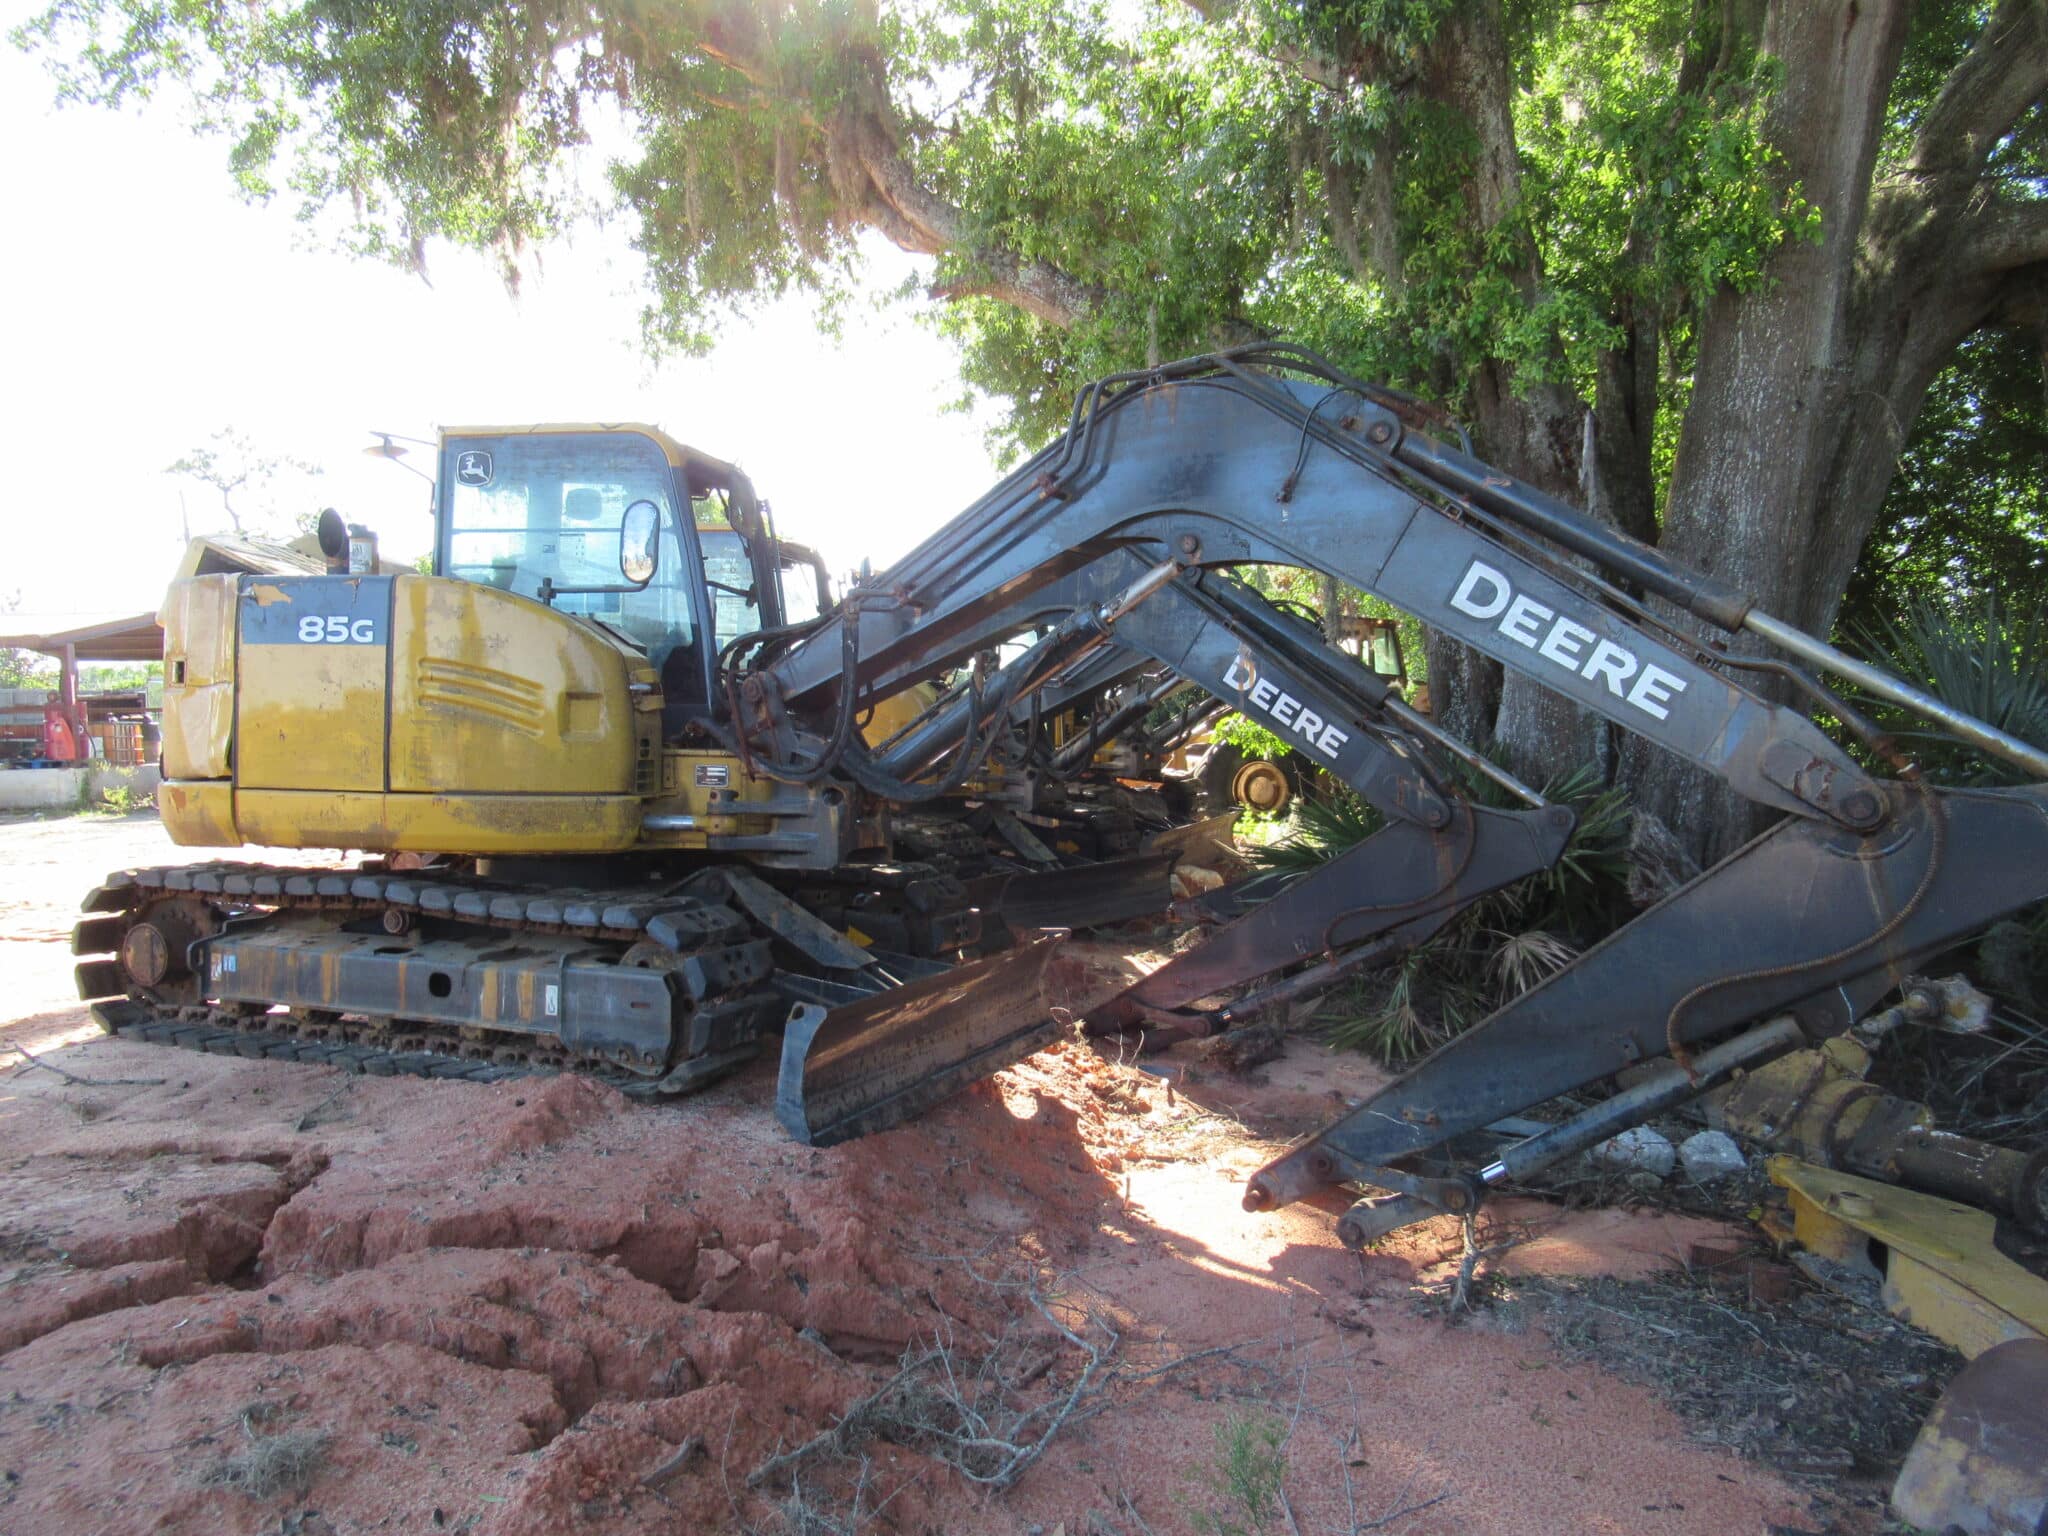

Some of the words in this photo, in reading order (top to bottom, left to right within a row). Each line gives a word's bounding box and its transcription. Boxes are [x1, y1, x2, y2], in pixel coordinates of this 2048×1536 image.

[298, 615, 374, 643] 85G
[1450, 560, 1688, 720] DEERE
[1222, 654, 1350, 759] DEERE
